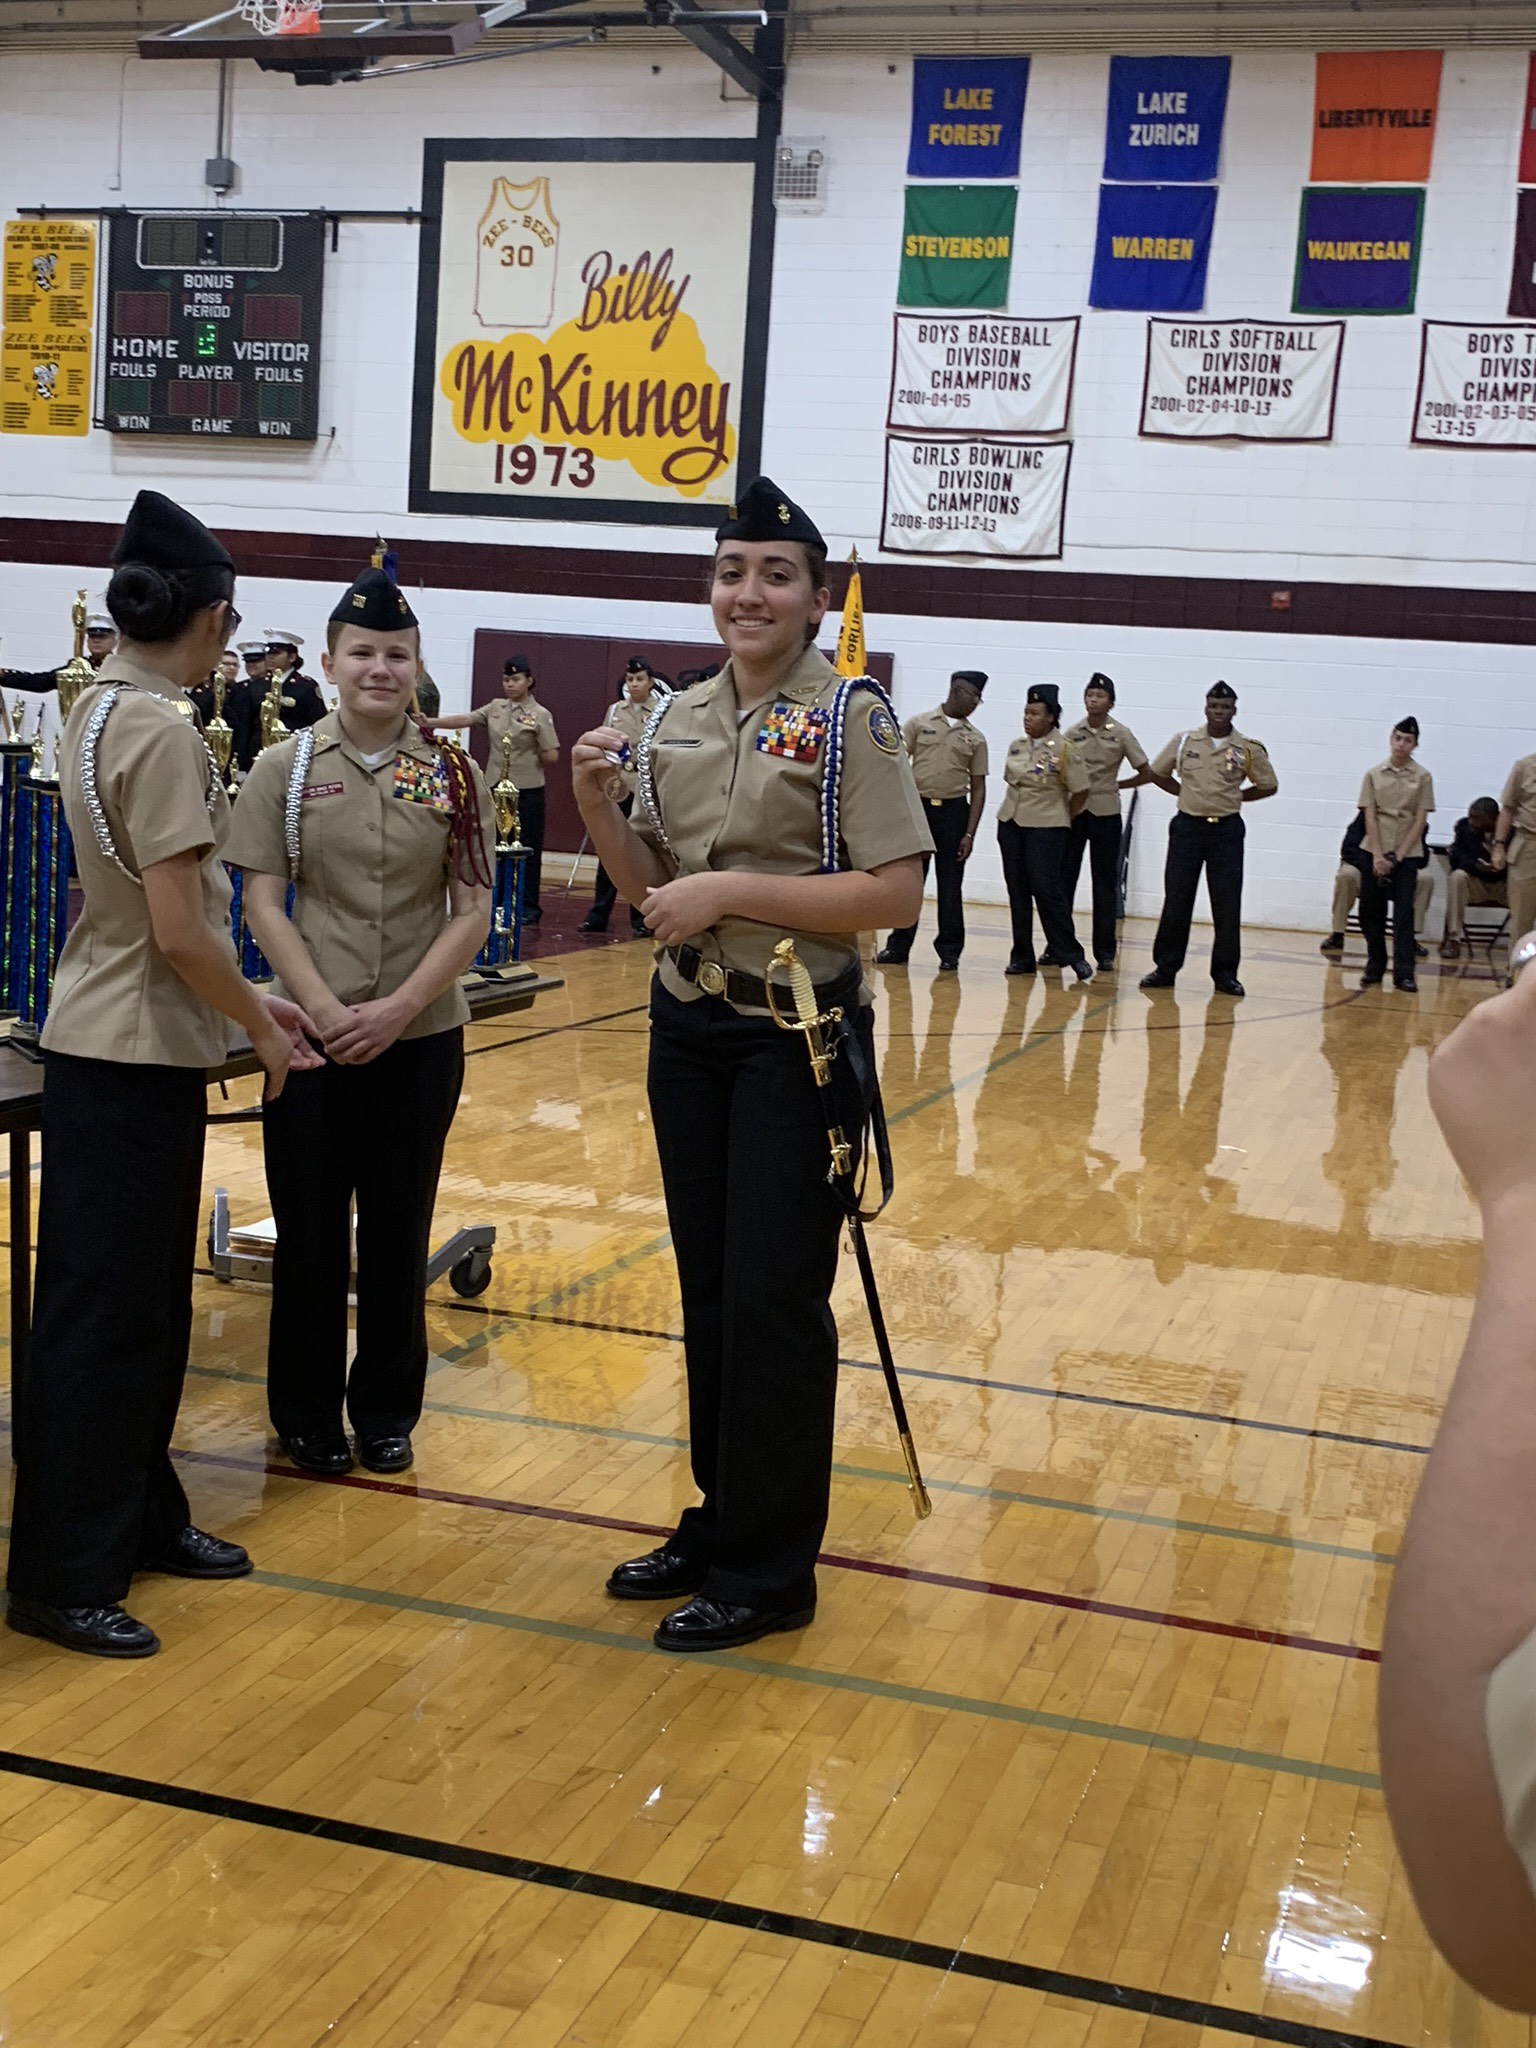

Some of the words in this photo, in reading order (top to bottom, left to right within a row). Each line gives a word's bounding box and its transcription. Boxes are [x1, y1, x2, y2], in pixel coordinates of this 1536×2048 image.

[943, 88, 994, 110] LAKE
[1137, 92, 1188, 115] LAKE
[1318, 108, 1432, 129] LIBERTYVILLE
[928, 123, 1003, 147] FOREST
[1129, 124, 1200, 147] ZURICH
[9, 225, 41, 235] ZEE
[46, 225, 90, 235] BEES
[500, 245, 533, 267] 30
[905, 235, 1010, 259] STEVENSON
[1112, 236, 1194, 260] WARREN
[1307, 240, 1411, 261] WAUKEGAN
[183, 274, 234, 289] BONUS
[194, 293, 222, 304] POSS
[574, 248, 692, 352] Billy
[183, 305, 231, 318] PERIOD
[5, 333, 39, 342] ZEE
[43, 334, 88, 343] BEES
[918, 325, 959, 344] BOYS
[968, 325, 1052, 347] BASEBALL
[1170, 329, 1221, 349] GIRLS
[1229, 329, 1318, 351] SOFTBALL
[1467, 333, 1515, 354] BOYS
[112, 338, 179, 358] HOME
[233, 341, 310, 362] VISITOR
[946, 348, 1021, 369] DIVISION
[109, 362, 157, 378] FOULS
[178, 365, 233, 380] PLAYER
[1202, 352, 1282, 375] DIVISION
[254, 367, 304, 382] FOULS
[931, 370, 1032, 392] CHAMPIONS
[1186, 376, 1294, 399] CHAMPIONS
[898, 389, 971, 408] 2001-04-05
[1150, 396, 1272, 416] 2001-02-04-10-13
[118, 415, 150, 429] WON
[454, 344, 731, 485] McKinney
[191, 418, 232, 433] GAME
[258, 421, 291, 435] WON
[494, 443, 596, 488] 1973
[913, 446, 960, 466] GIRLS
[969, 447, 1044, 470] BOWLING
[938, 470, 1014, 492] DIVISION
[927, 493, 1020, 516] CHAMPIONS
